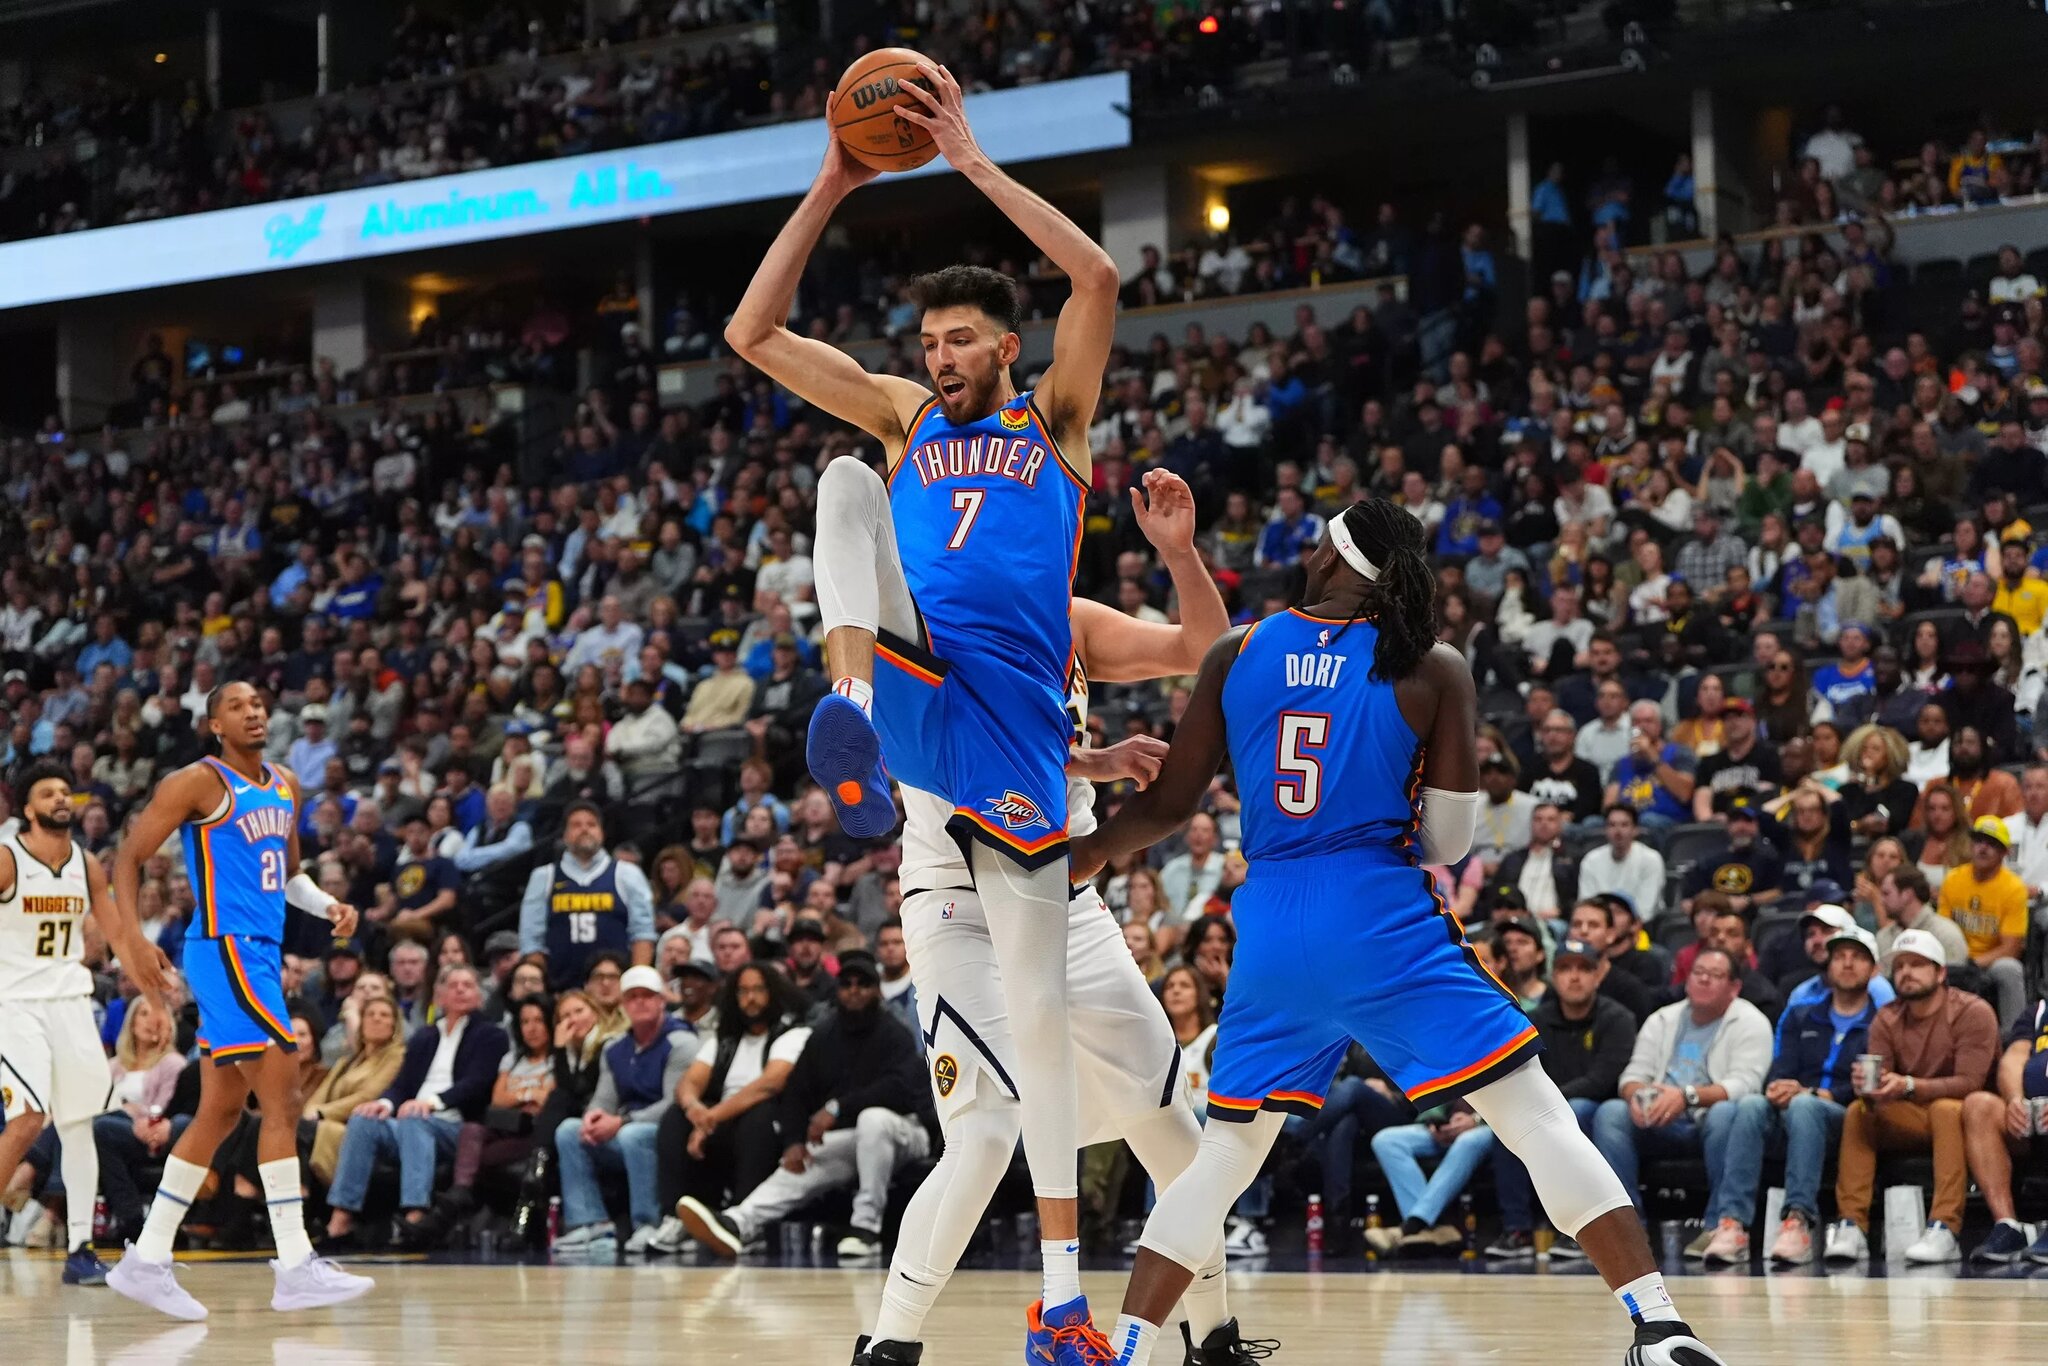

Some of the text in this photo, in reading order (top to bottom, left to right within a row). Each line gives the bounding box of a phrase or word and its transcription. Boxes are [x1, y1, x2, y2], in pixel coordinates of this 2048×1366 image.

[361, 161, 674, 240] Aluminum. All in.
[911, 434, 1047, 489] THUNDER
[945, 488, 986, 550] 7
[1286, 653, 1347, 688] DORT
[1274, 710, 1332, 819] 5
[995, 801, 1034, 817] OKC
[260, 848, 288, 892] 21
[22, 895, 84, 914] NUGGETS
[552, 892, 615, 913] DENVER
[36, 920, 74, 957] 27
[568, 911, 597, 944] 15
